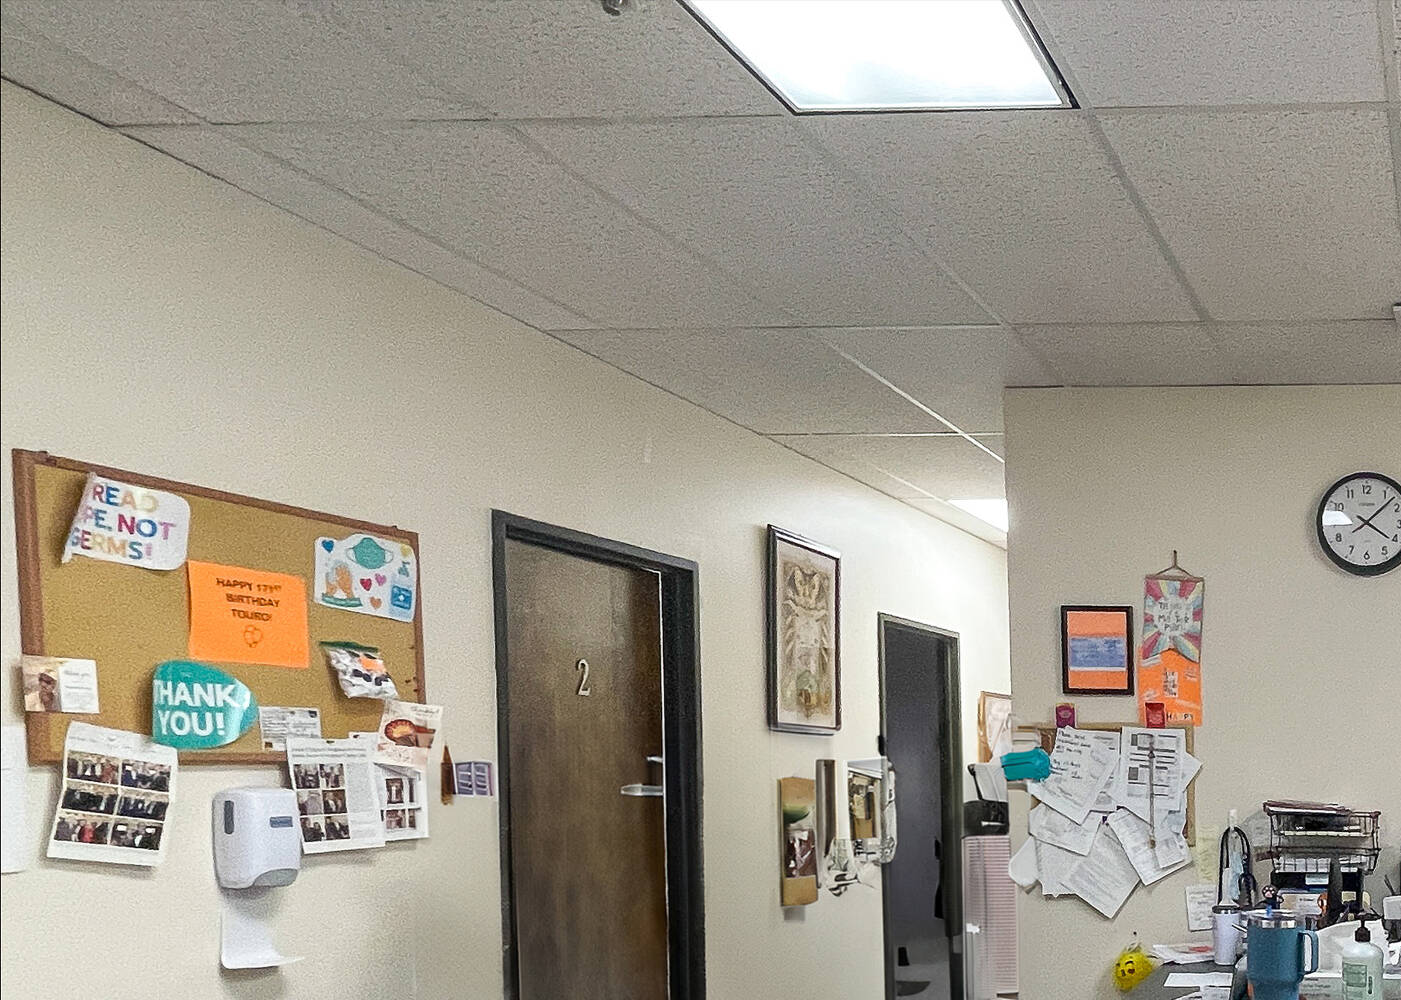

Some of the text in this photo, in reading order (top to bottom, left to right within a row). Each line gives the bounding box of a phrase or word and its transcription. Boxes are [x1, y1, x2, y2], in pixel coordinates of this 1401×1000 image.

[1346, 489, 1355, 499] 11
[1361, 484, 1372, 495] 12
[1393, 503, 1400, 513] 2
[117, 513, 176, 540] NOT
[1335, 533, 1342, 542] 8
[1391, 534, 1399, 543] 4
[1348, 545, 1355, 555] 7
[1363, 550, 1370, 560] 6
[1381, 546, 1388, 555] 5
[215, 577, 254, 591] HAPPY
[225, 593, 281, 608] BIRTHDAY
[577, 659, 591, 696] 2
[158, 710, 225, 737] YOU!
